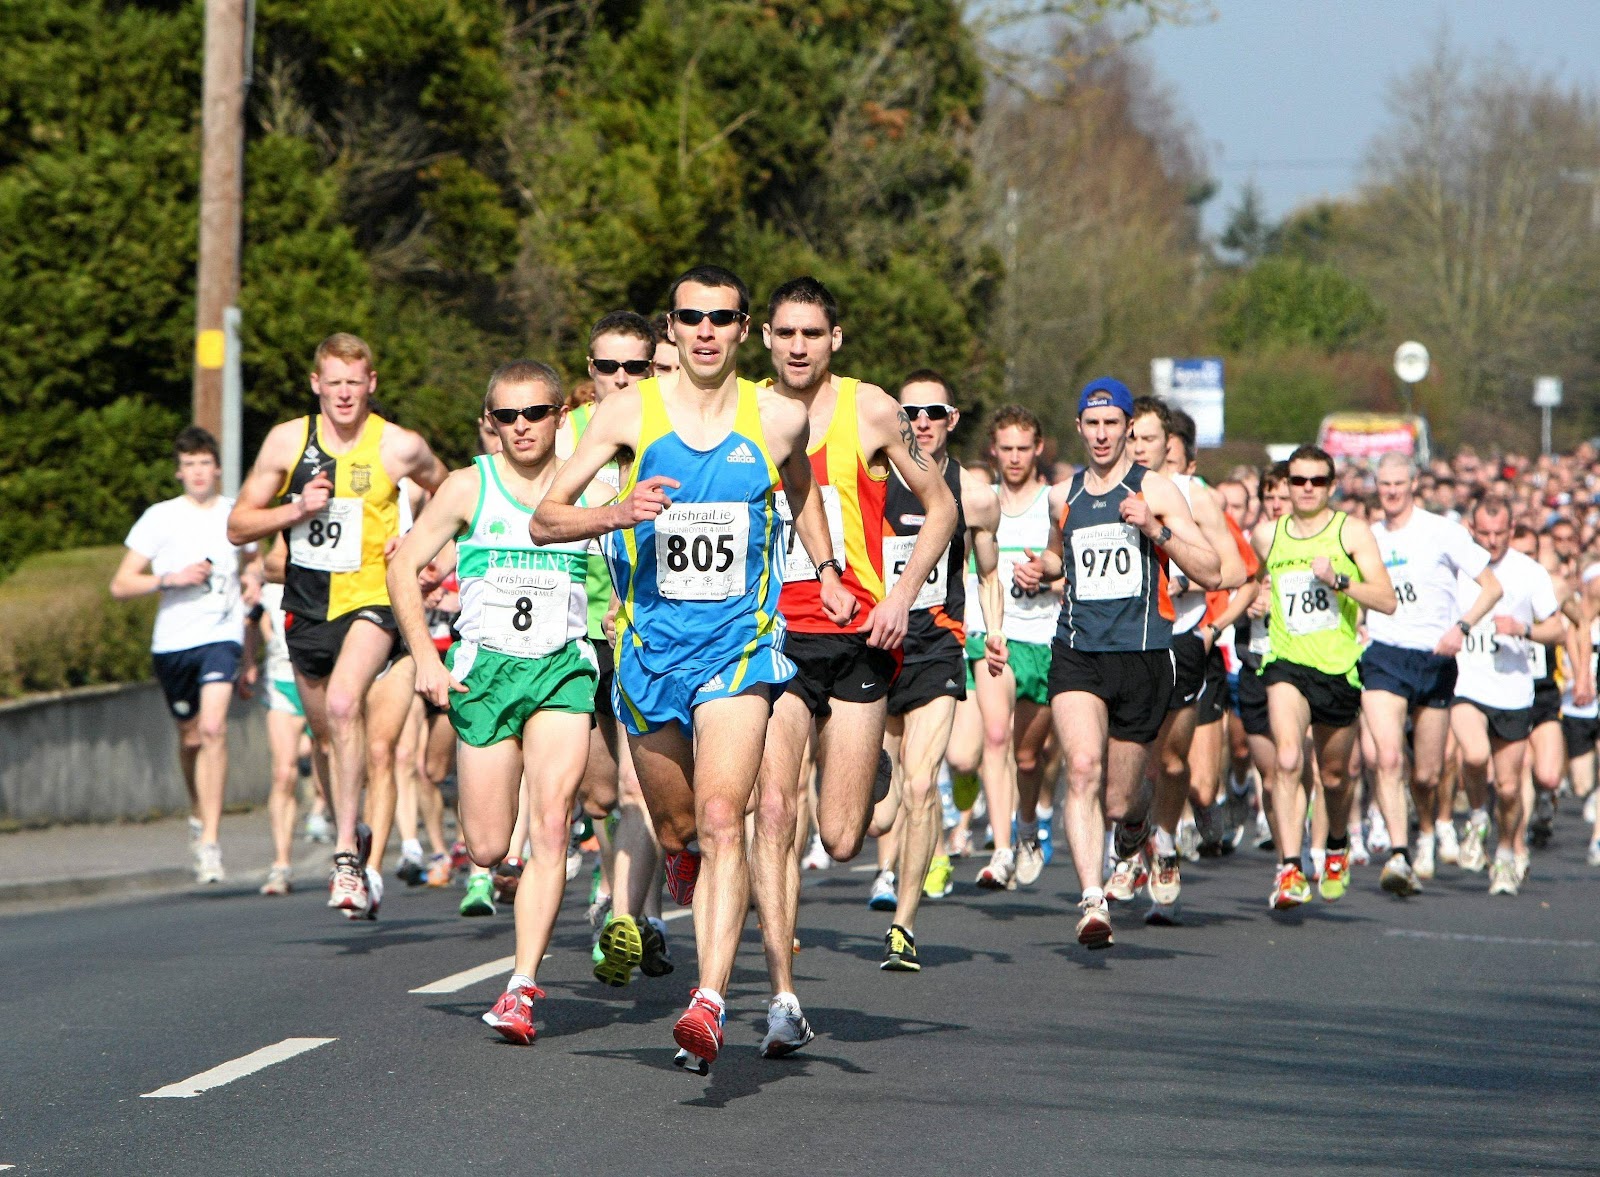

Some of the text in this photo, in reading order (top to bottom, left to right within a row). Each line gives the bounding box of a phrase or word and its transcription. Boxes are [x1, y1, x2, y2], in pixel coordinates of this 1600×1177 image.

[668, 509, 731, 521] irishrail.ie
[308, 519, 342, 549] 89
[488, 550, 575, 572] RAHENY
[667, 534, 734, 573] 805
[1082, 547, 1131, 578] 970
[496, 574, 555, 586] irishrail.ie
[512, 596, 533, 632] 8
[1285, 587, 1330, 617] 788
